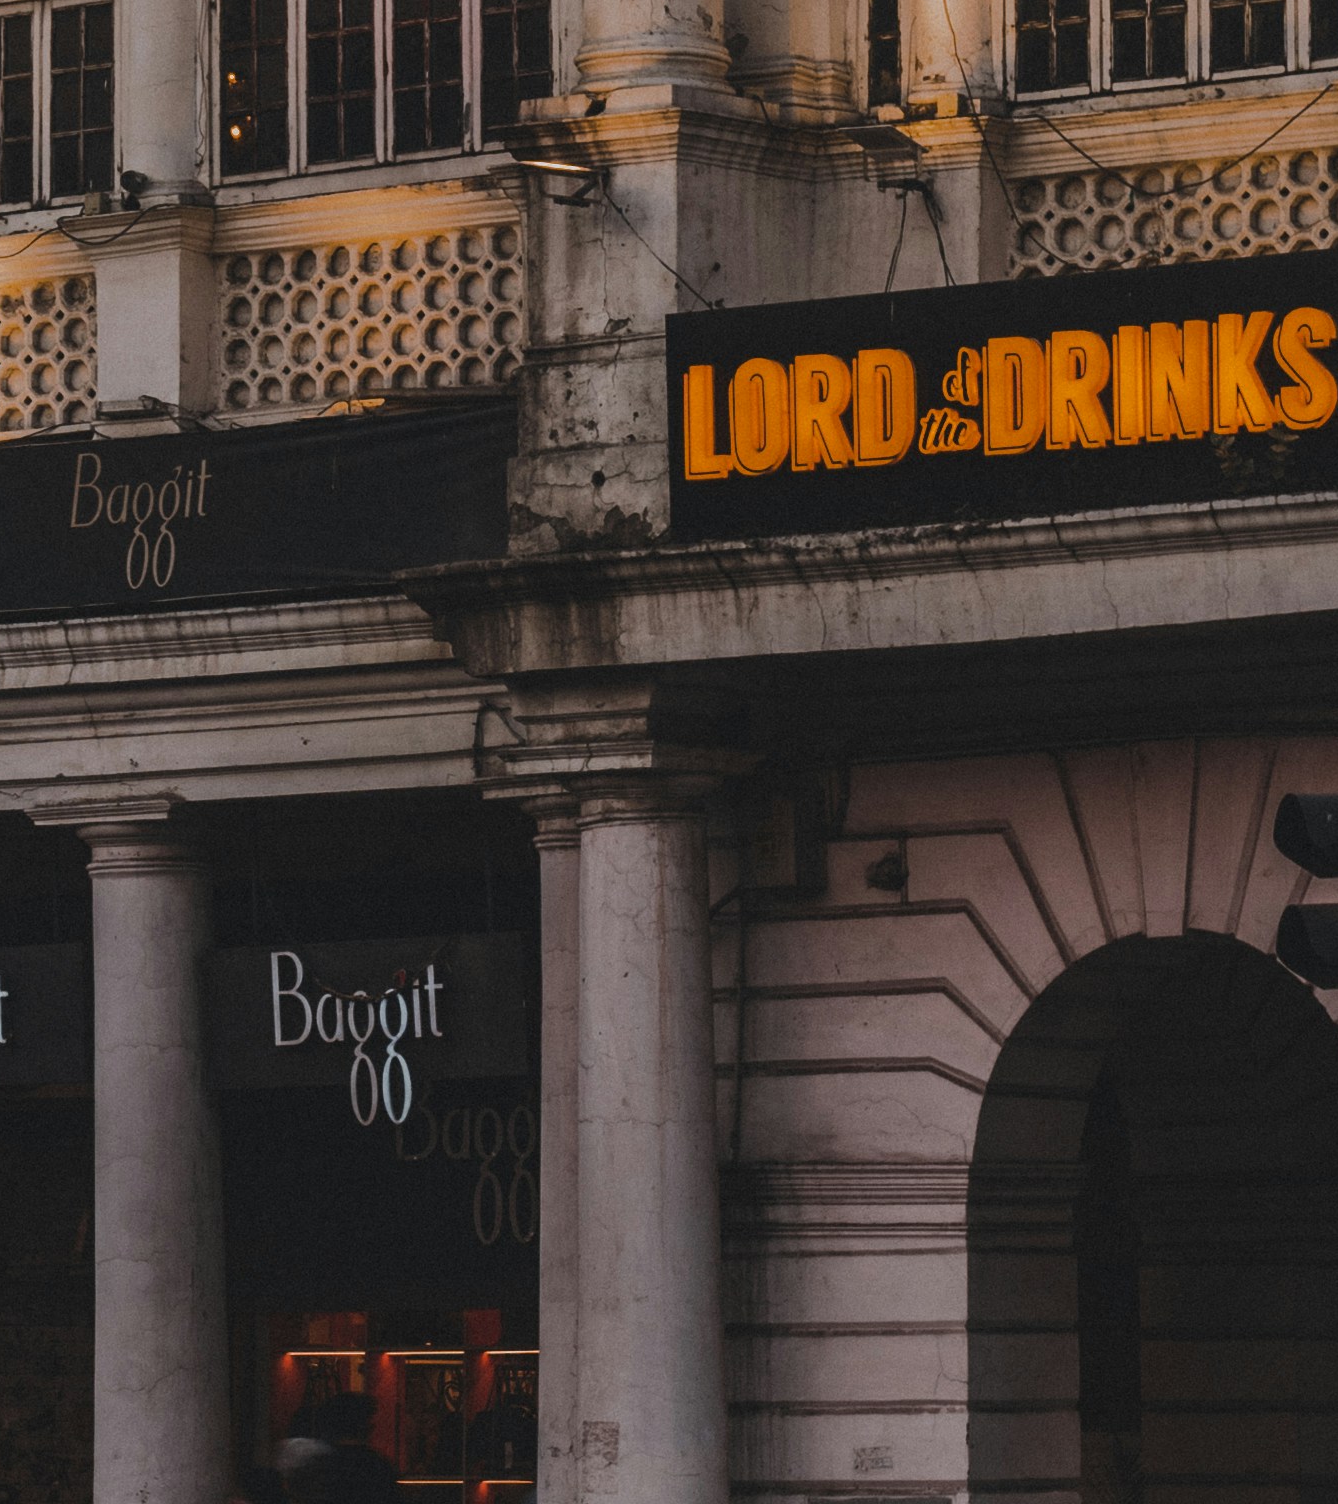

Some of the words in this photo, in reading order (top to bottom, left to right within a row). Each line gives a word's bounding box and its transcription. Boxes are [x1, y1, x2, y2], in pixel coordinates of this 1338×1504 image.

[683, 348, 918, 482] LORD
[918, 407, 982, 455] the
[942, 346, 983, 408] of
[70, 451, 212, 591] Baggit
[271, 950, 445, 1127] Baggit
